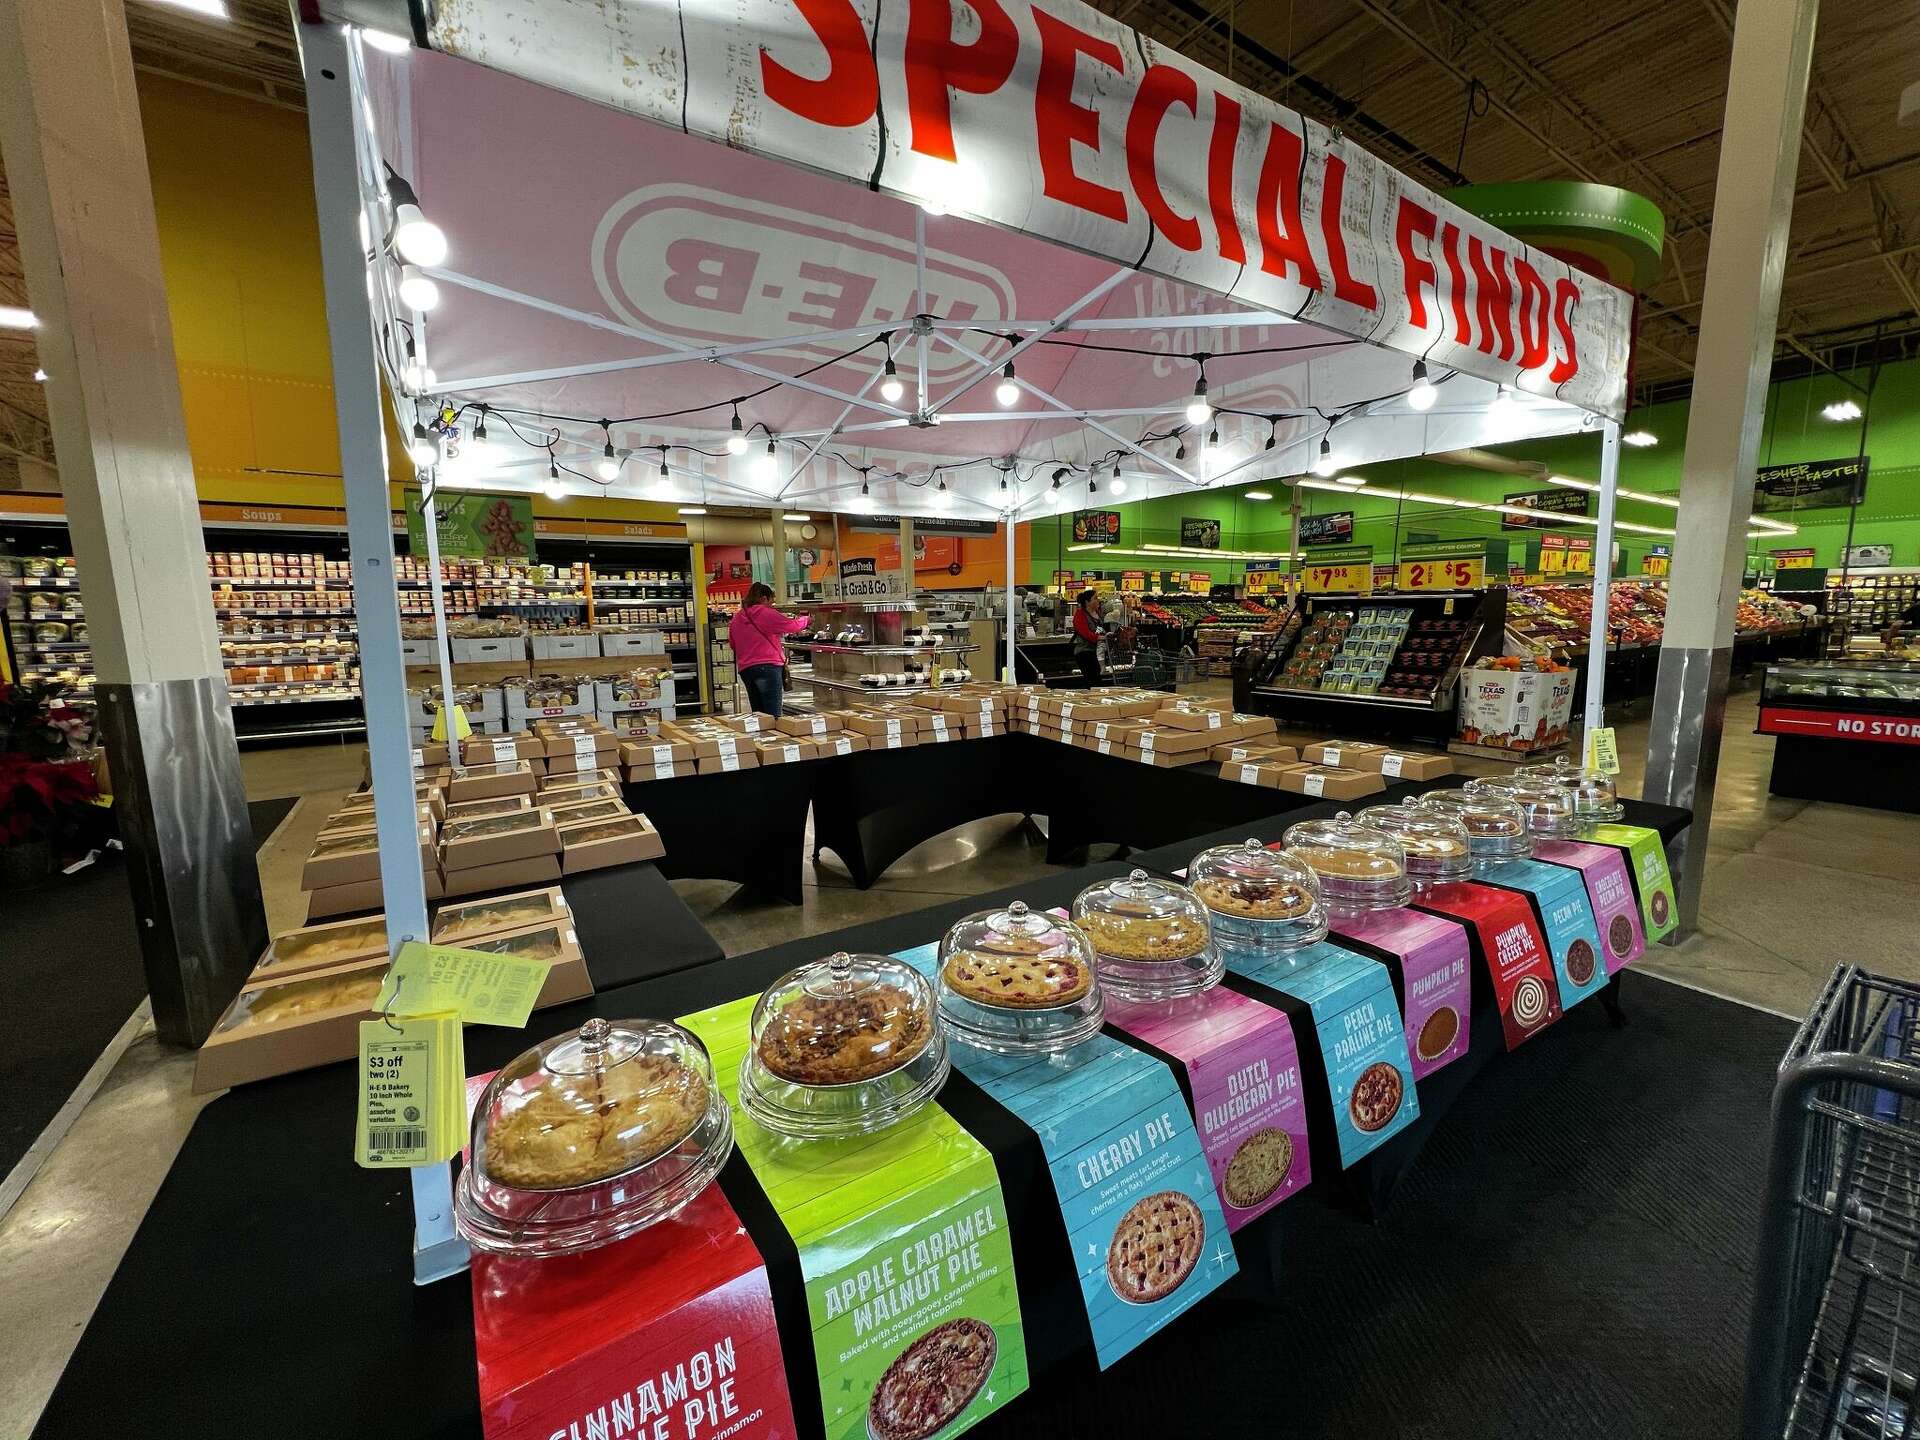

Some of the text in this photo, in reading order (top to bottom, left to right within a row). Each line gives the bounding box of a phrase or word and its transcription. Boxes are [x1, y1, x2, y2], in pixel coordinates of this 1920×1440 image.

[760, 0, 1581, 384] SPECIAL FINDS
[1755, 465, 1810, 483] RESHER
[242, 508, 282, 522] Soups
[625, 526, 653, 536] Salads
[857, 561, 873, 571] Fresh
[1410, 564, 1425, 587] 2
[1445, 561, 1472, 587] $5
[849, 581, 868, 596] Grab
[868, 580, 874, 595] &
[875, 580, 887, 594] Go
[1478, 685, 1505, 695] TEXAS
[1837, 719, 1920, 738] NO STOR
[1553, 904, 1573, 926] PECAN
[1572, 899, 1583, 916] PIE
[1495, 921, 1529, 950] PUMPKIN
[1497, 934, 1536, 967] CHEESE PIE
[1412, 965, 1450, 999] PUMPKIN
[1452, 957, 1465, 977] PIE
[1343, 1002, 1376, 1035] PEACH
[1334, 1023, 1377, 1063] PRALINE
[1376, 1013, 1394, 1038] PIE
[369, 1069, 400, 1080] two (2)
[370, 1055, 404, 1069] $3 off
[1227, 1058, 1269, 1098] DUTCH
[388, 1084, 410, 1092] Bakery
[1203, 1066, 1297, 1135] BLUEBERRY PIE
[1077, 1112, 1177, 1189] CHERRY PIE
[1090, 1198, 1116, 1216] cherries
[1116, 1191, 1124, 1200] in
[1144, 1164, 1167, 1182] latticed
[1100, 1181, 1120, 1199] Sweet
[1119, 1171, 1139, 1187] meets
[1151, 1151, 1170, 1169] bright
[824, 1205, 997, 1321] APPLE CARAMEL
[853, 1242, 983, 1337] WALNUT PIE
[839, 1265, 999, 1364] Baked with ooey-gooey caramel filling
[881, 1294, 966, 1350] and walnut topping.
[684, 1377, 740, 1440] PIE
[711, 1407, 764, 1440] cinnamon
